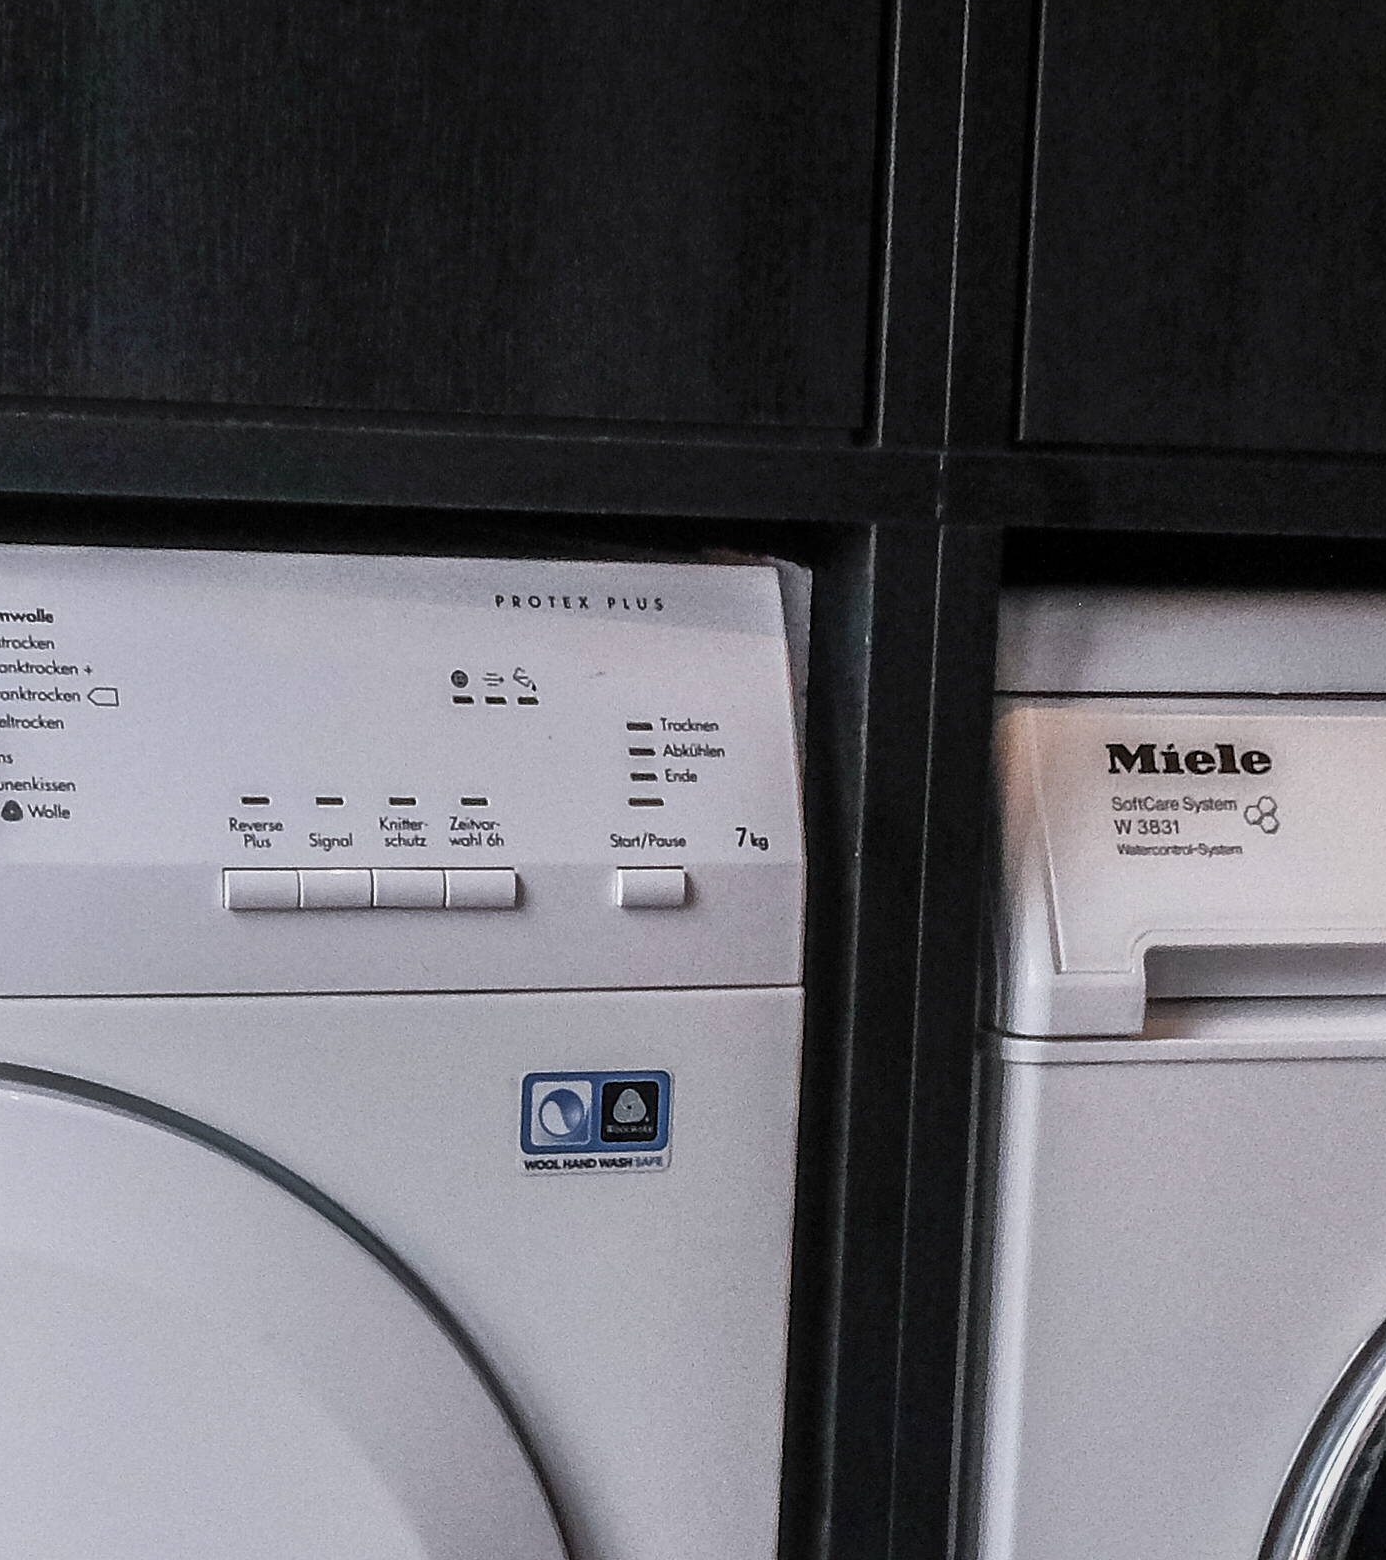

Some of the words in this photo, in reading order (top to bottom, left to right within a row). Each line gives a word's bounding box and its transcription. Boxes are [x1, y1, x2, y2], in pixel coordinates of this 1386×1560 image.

[495, 594, 589, 610] PROTEX
[607, 596, 666, 611] PLUS
[660, 717, 719, 732] Trocknen
[663, 742, 726, 759] Abkühlen
[1107, 742, 1273, 775] Miele
[664, 768, 698, 783] Ende
[28, 804, 71, 821] Wolle
[1111, 795, 1180, 812] SoftCare
[1182, 796, 1238, 816] System
[229, 817, 284, 834] Reverse
[379, 816, 429, 832] Knitter-
[449, 816, 501, 832] Zeitvor-
[1114, 819, 1133, 835] W
[1137, 819, 1182, 835] 3831
[243, 834, 272, 850] Plus
[309, 833, 353, 851] Signal
[384, 834, 428, 850] schutz
[449, 833, 482, 849] wahl
[486, 833, 505, 849] 6h
[610, 832, 687, 851] Start/Pause
[735, 827, 748, 848] 7
[749, 833, 770, 852] kg
[1116, 842, 1244, 857] Watercontrol-System
[524, 1158, 561, 1171] WOOL
[564, 1157, 597, 1170] HAND
[598, 1156, 633, 1169] WASH
